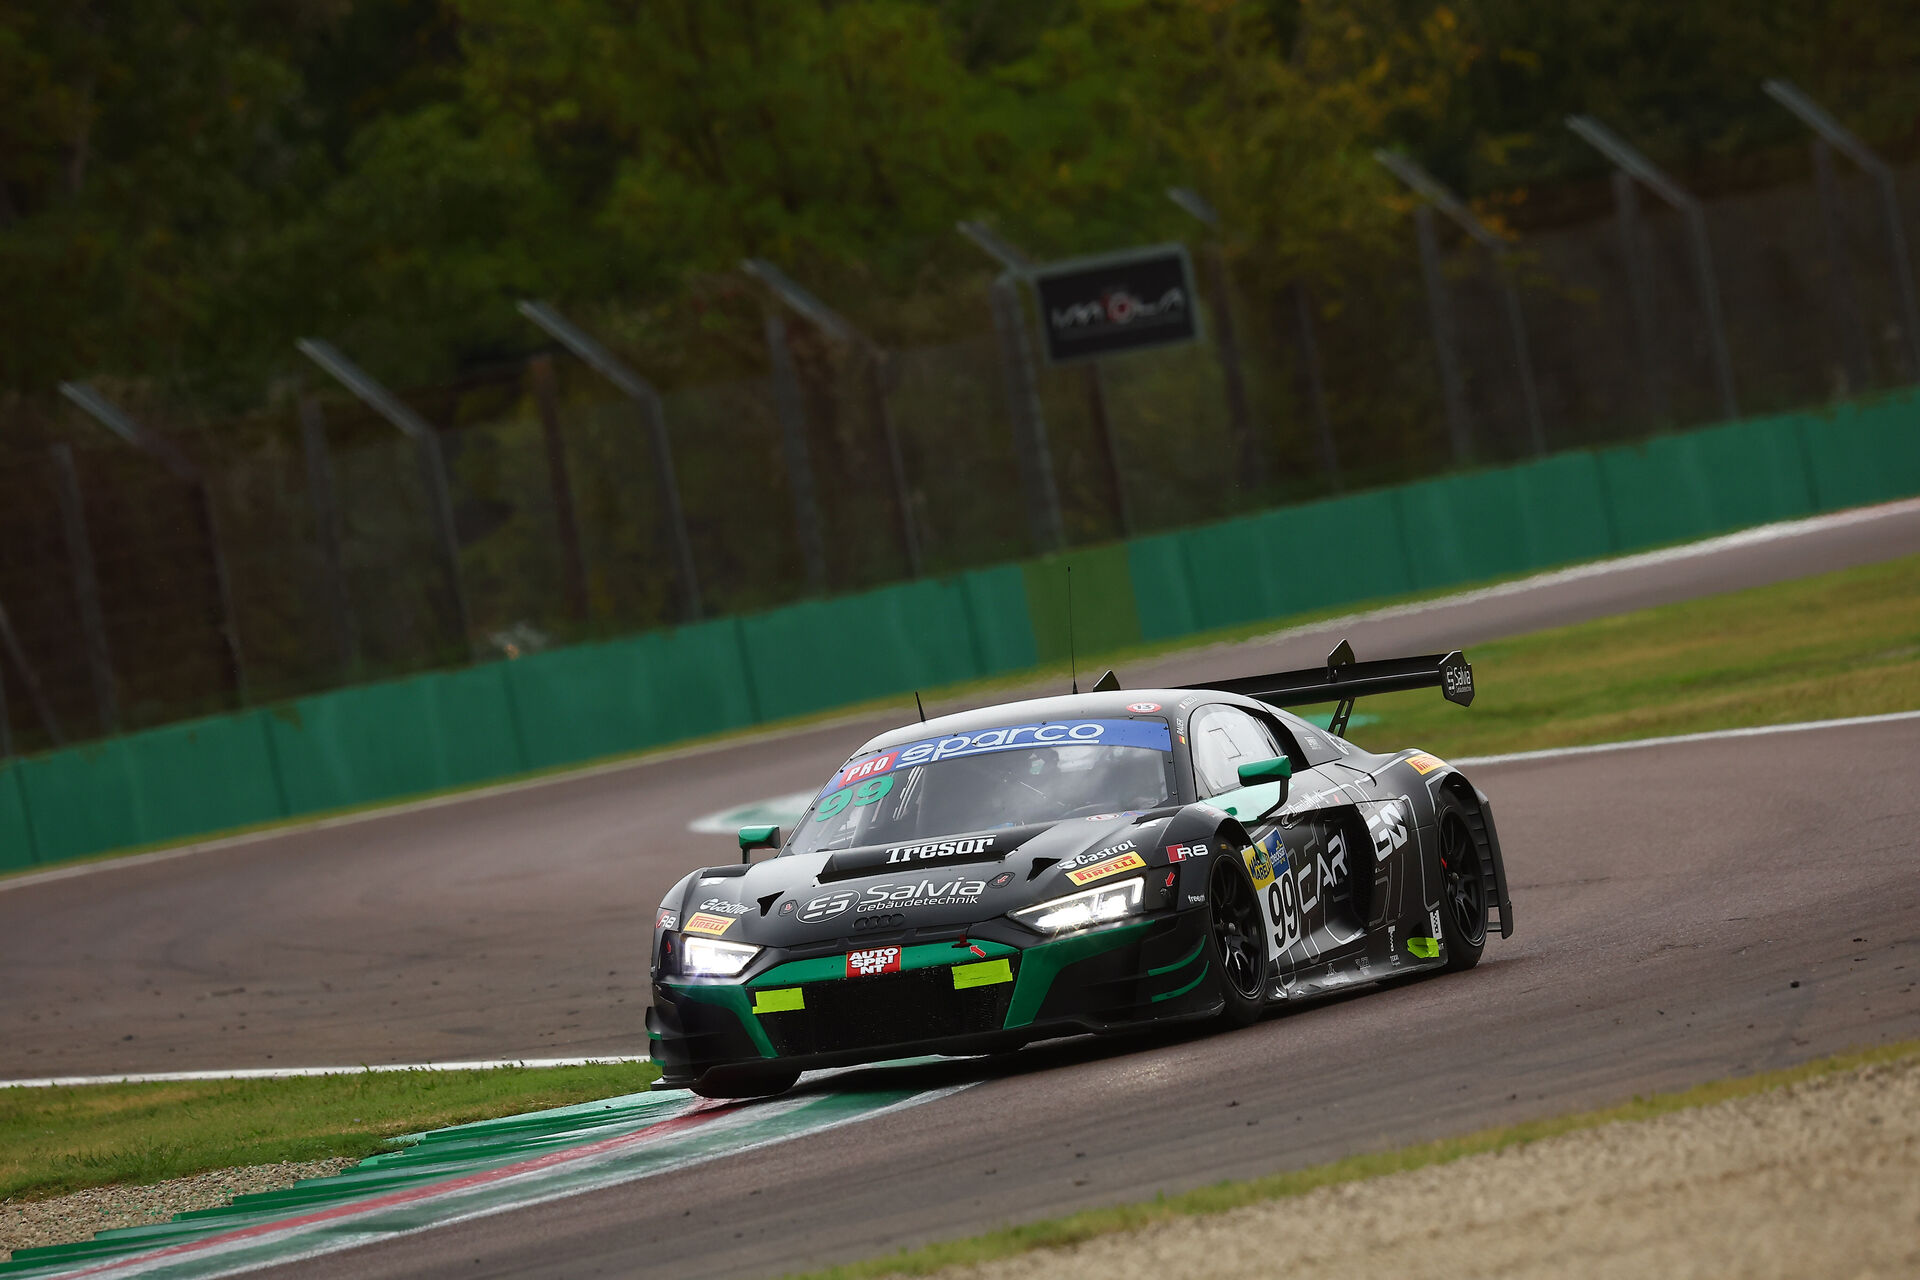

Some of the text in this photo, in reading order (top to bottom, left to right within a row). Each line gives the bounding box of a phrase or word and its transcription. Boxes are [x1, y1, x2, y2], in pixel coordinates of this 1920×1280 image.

[900, 723, 1105, 764] sparco
[845, 756, 890, 782] PRO
[815, 776, 894, 822] 99
[885, 836, 997, 864] Tresor
[1075, 840, 1137, 865] Castrol
[1176, 844, 1208, 859] R8
[1074, 855, 1137, 881] PIRELLI
[860, 877, 987, 904] Salvia
[711, 900, 753, 914] Castrol
[856, 895, 978, 913] Gebäudetechnik
[1268, 872, 1298, 949] 99
[660, 915, 676, 928] R8
[689, 916, 728, 931] PIRELLI
[849, 947, 899, 962] AUTO
